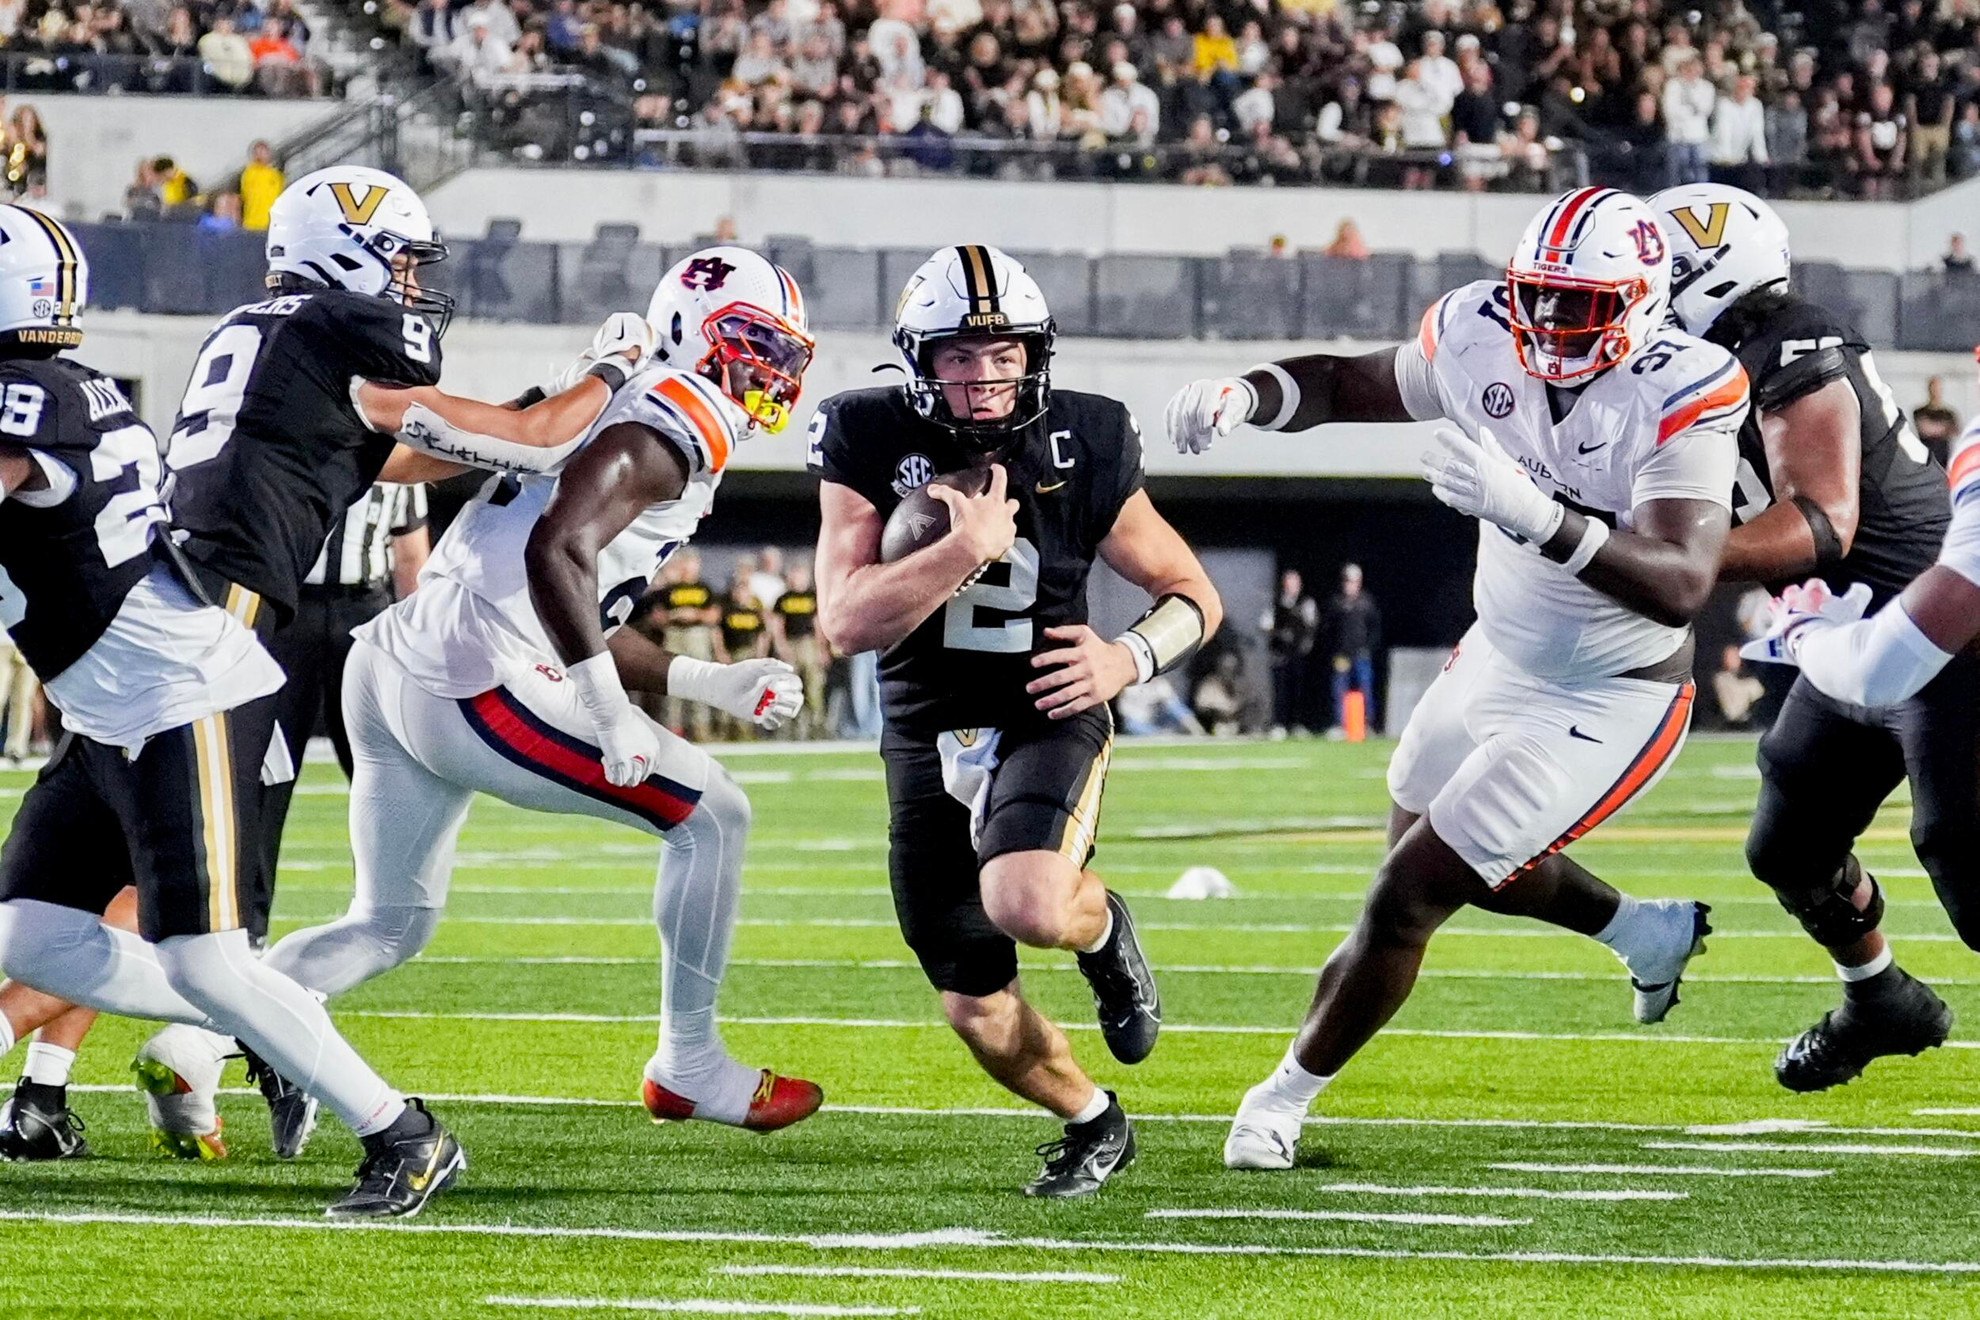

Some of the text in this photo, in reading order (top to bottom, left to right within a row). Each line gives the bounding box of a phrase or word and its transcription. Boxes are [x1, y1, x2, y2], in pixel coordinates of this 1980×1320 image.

[327, 183, 390, 226] V
[1665, 203, 1730, 250] V
[1533, 262, 1568, 275] TIGERS
[402, 304, 431, 364] 9
[966, 314, 1004, 327] VUFB
[0, 383, 45, 437] 8
[165, 325, 263, 471] 9
[806, 410, 828, 467] 2
[1049, 430, 1076, 469] C
[898, 455, 932, 489] SEC
[943, 537, 1040, 653] 2
